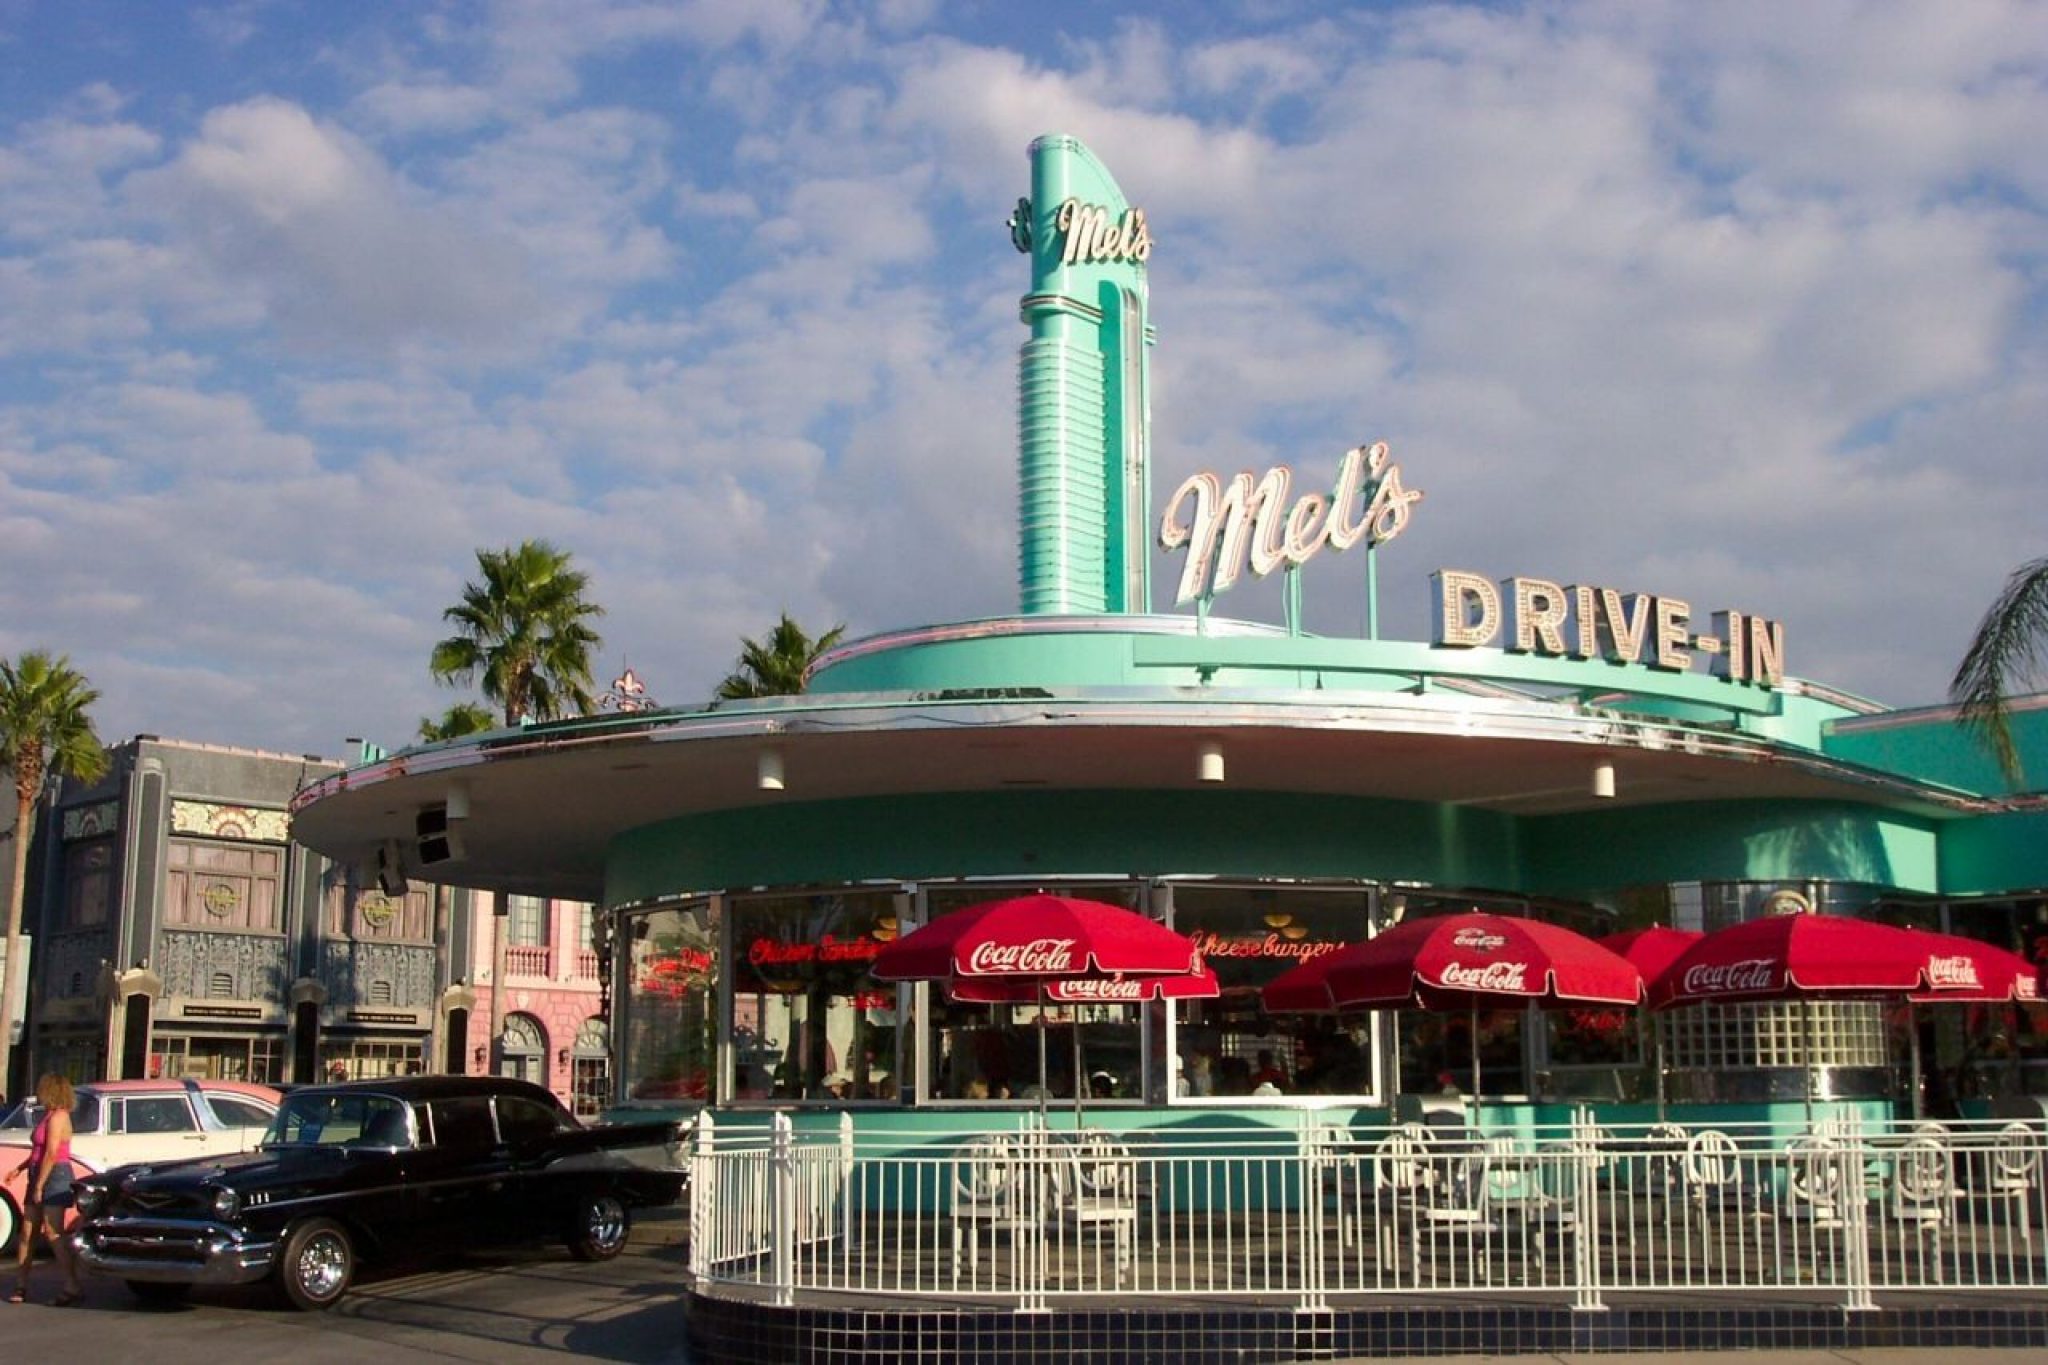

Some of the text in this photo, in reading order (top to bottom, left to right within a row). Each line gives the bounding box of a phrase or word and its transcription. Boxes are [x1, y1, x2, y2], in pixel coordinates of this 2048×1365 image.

[1056, 197, 1154, 265] Mel's
[1158, 440, 1423, 606] Mel's
[1428, 568, 1786, 689] DRIVE-IN
[970, 938, 1076, 973] Coca-Cola
[1928, 954, 1978, 985] Coca-Cola
[1440, 961, 1528, 991] Coca-Cola
[1684, 957, 1777, 993] Coca-Cola
